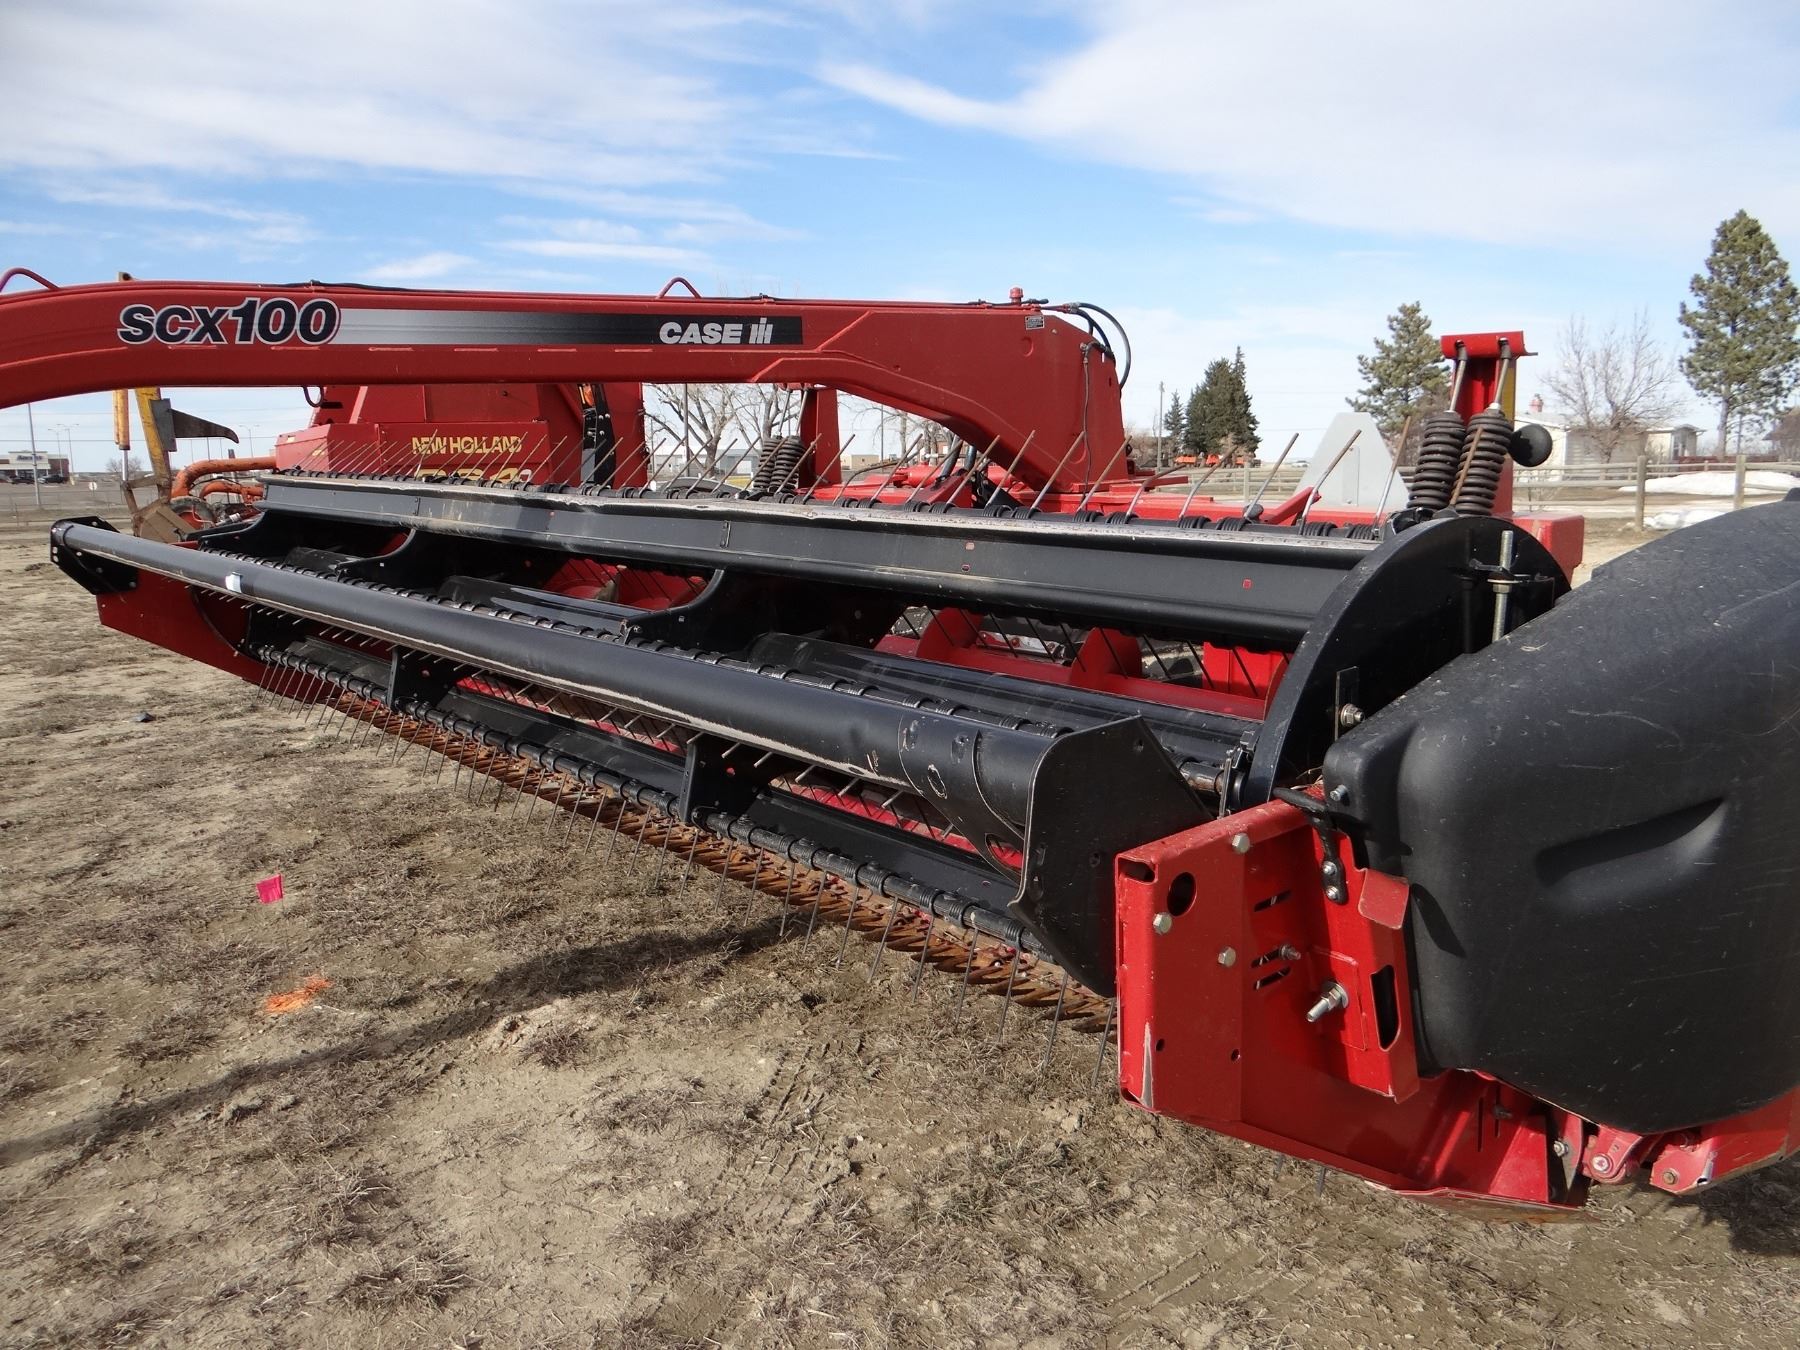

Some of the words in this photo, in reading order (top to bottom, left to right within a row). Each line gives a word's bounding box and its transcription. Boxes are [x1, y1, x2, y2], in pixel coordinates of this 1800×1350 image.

[117, 297, 340, 345] SCX100
[659, 321, 743, 344] CASE
[412, 436, 447, 454] NEW
[450, 436, 522, 453] HOLLAND
